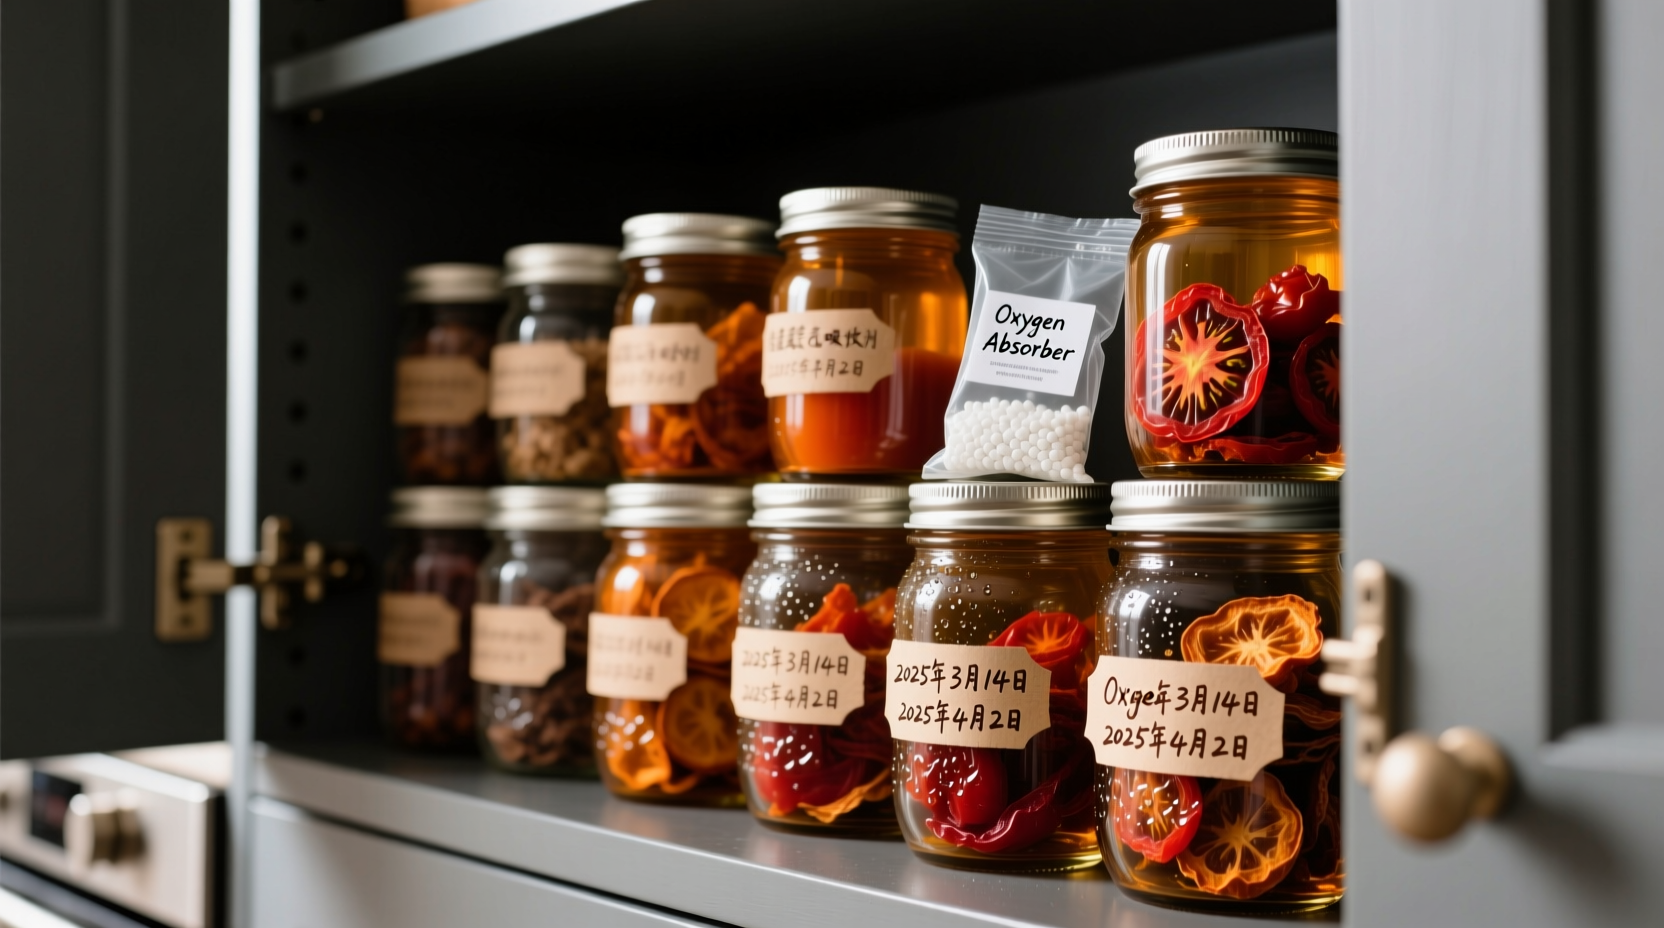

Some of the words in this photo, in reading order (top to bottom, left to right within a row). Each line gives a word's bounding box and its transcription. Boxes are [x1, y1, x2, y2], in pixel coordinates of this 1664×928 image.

[995, 304, 1065, 338] Oxygen
[982, 332, 1075, 361] Absorber
[742, 646, 849, 676] 2025年3月14日
[894, 658, 1027, 694] 2025年3月14日
[898, 700, 1021, 734] 2025年4月2日
[1103, 721, 1248, 760] 2025年4月2日
